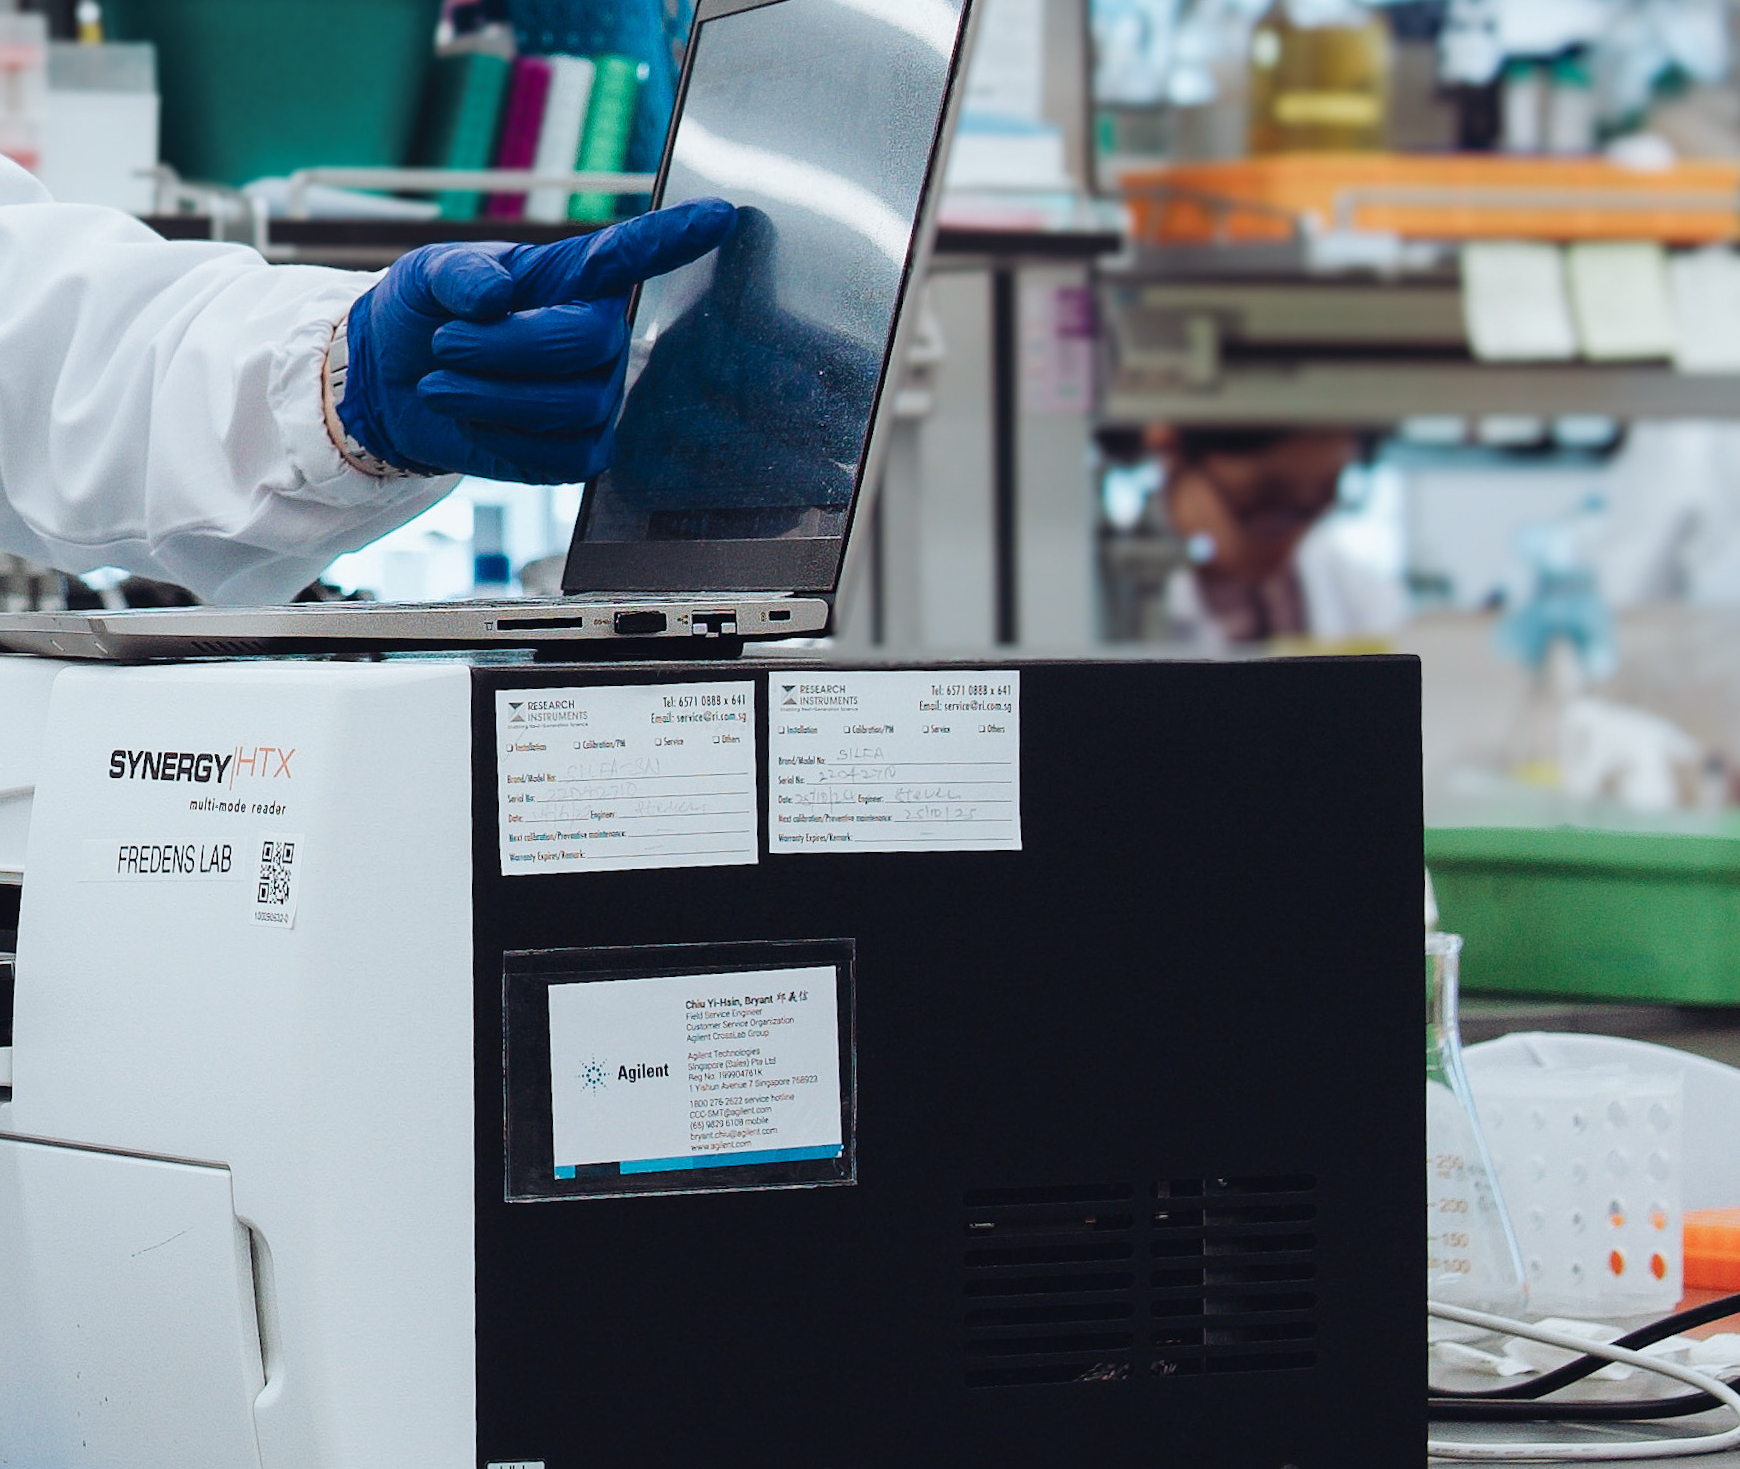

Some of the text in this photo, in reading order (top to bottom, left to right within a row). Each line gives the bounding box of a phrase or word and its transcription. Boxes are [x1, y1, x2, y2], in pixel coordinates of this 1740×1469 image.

[800, 684, 846, 694] RESEARCH
[931, 684, 1012, 696] Tel: 6571 0888 x 641
[527, 699, 575, 710] RESEARCH
[663, 694, 746, 707] Tel: 6571 0888 x 641
[800, 695, 858, 706] INSTRUMENTS
[919, 700, 1012, 713] Email: service@ri.com.sg
[527, 711, 588, 722] INSTRUMENTS
[651, 710, 747, 723] Email: service@ri.com.sg
[787, 725, 818, 734] Installation
[930, 725, 950, 733] Service
[987, 724, 1005, 733] Others
[663, 737, 684, 746] Service
[721, 734, 741, 743] Others
[109, 746, 296, 784] SYNERGY HTX
[778, 756, 816, 766] Brand/Model
[778, 775, 794, 784] Serial
[507, 794, 524, 803] Serial
[190, 797, 287, 816] multi-mode reader
[118, 844, 233, 874] FREDENS LAB
[685, 999, 706, 1010] Chiu
[744, 995, 774, 1007] Bryant
[686, 1008, 763, 1021] Field Service Engineer
[686, 1016, 796, 1032] Customer Service Organization
[686, 1033, 712, 1044] Agilent
[747, 1029, 770, 1038] Group
[687, 1047, 761, 1061] Agilent Technologies
[688, 1060, 724, 1072] Singapore
[764, 1056, 777, 1065] Ltd
[618, 1062, 670, 1083] Agilent
[688, 1073, 703, 1082] Reg
[720, 1081, 748, 1090] Avenue
[755, 1078, 791, 1089] Singapore
[744, 1096, 769, 1104] service
[770, 1093, 795, 1102] hotline
[744, 1116, 769, 1125] mobile
